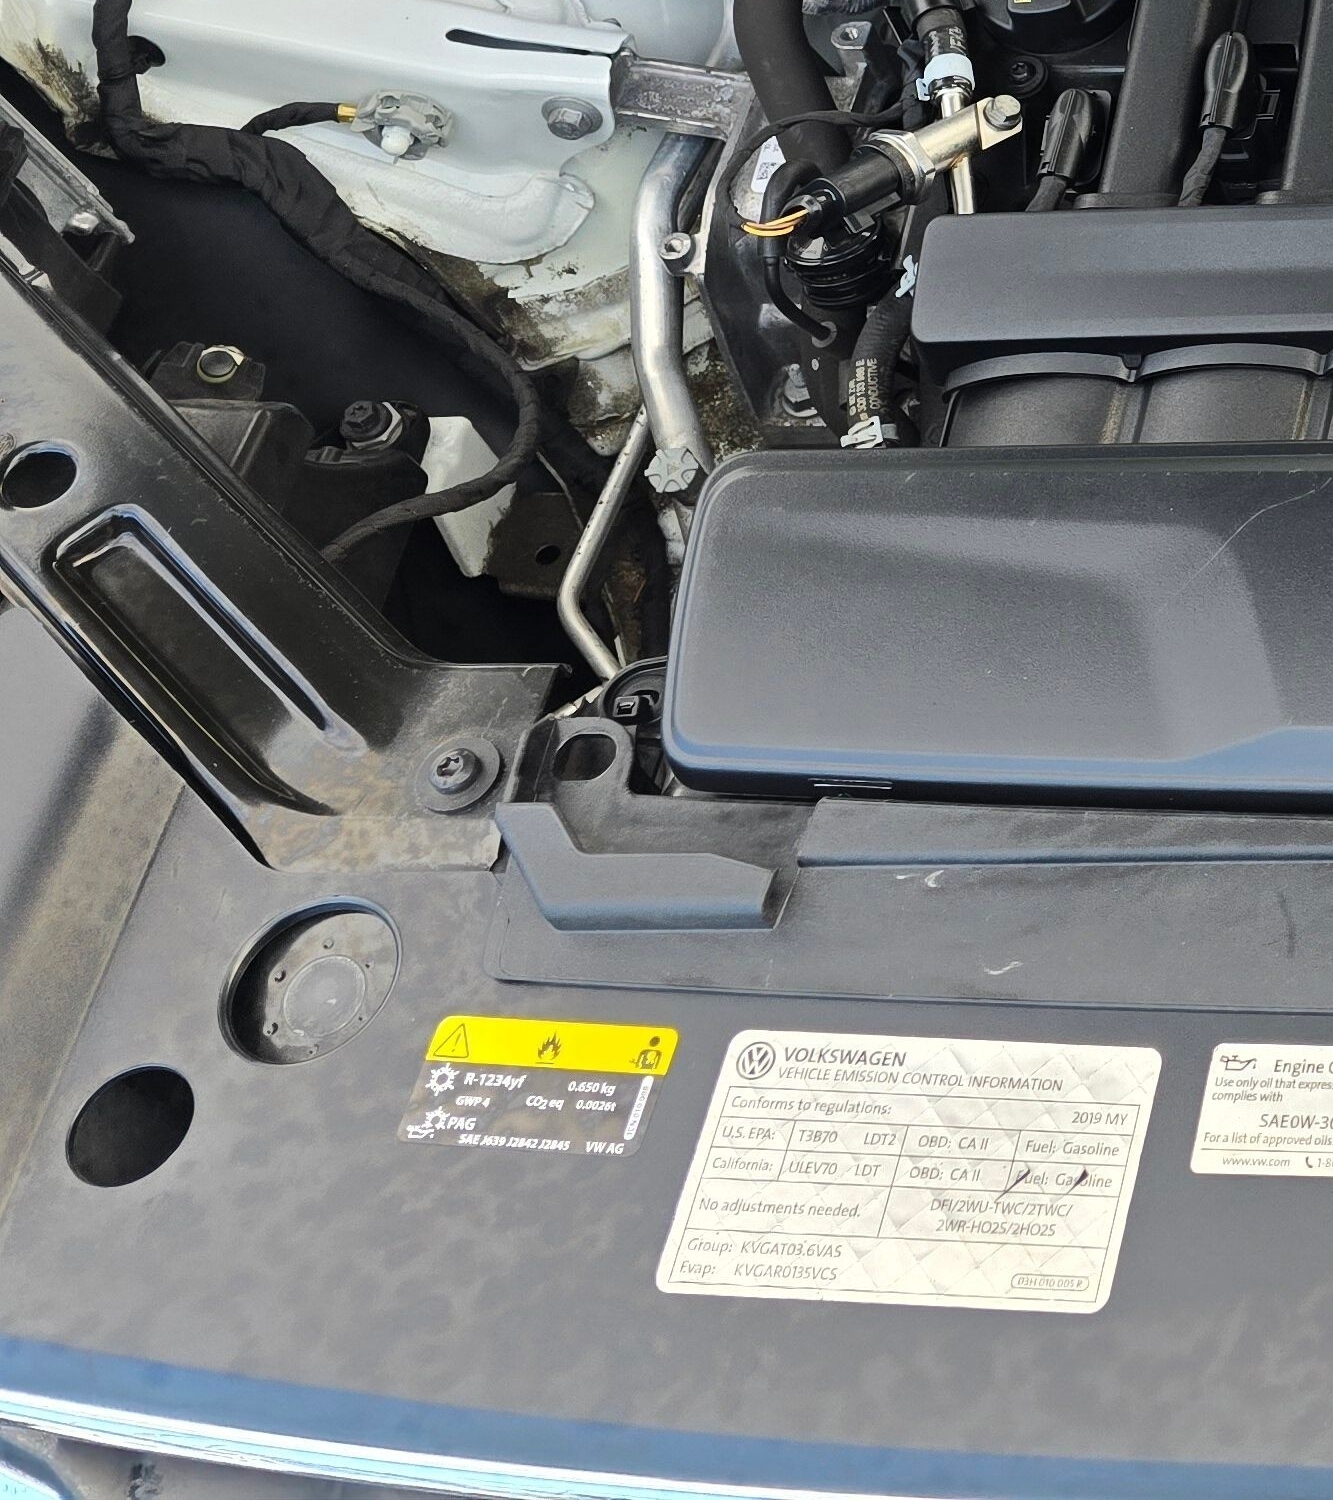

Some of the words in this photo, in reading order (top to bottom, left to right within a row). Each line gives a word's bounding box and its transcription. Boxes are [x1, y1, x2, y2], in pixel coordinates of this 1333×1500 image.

[867, 358, 881, 409] CONDUCTIVE
[784, 1046, 908, 1068] VOLKSWAGEN
[1273, 1058, 1325, 1079] Engine
[462, 1071, 528, 1092] R-1234yf
[778, 1066, 832, 1082] VEHICLE
[832, 1068, 901, 1085] EMISSION
[901, 1071, 965, 1088] CONTROL
[967, 1075, 1064, 1092] INFORMATION
[1214, 1076, 1235, 1088] Use
[1235, 1077, 1260, 1092] only
[1259, 1077, 1274, 1089] oil
[1273, 1077, 1297, 1090] that
[1211, 1090, 1259, 1103] complies
[1259, 1091, 1284, 1103] with
[730, 1095, 796, 1111] Conforms
[796, 1097, 817, 1111] to
[813, 1097, 893, 1118] regulations:
[1070, 1110, 1103, 1126] 2019
[1104, 1112, 1129, 1127] MY
[721, 1124, 746, 1140] U.S.
[747, 1126, 776, 1142] EPA:
[798, 1128, 839, 1144] T3B70
[862, 1131, 897, 1147] LDT2
[1202, 1131, 1222, 1144] For
[1230, 1131, 1248, 1145] list
[1248, 1131, 1264, 1145] of
[1261, 1133, 1314, 1148] approved
[917, 1134, 952, 1150] OBD:
[957, 1136, 977, 1151] CA
[1024, 1139, 1057, 1155] Fuel:
[1062, 1140, 1120, 1157] Gasoline
[711, 1156, 774, 1173] California:
[788, 1160, 839, 1176] ULEV70
[853, 1162, 883, 1178] LDT
[1221, 1156, 1291, 1168] www.vw.com
[908, 1165, 945, 1181] OBD:
[949, 1167, 969, 1182] CA
[698, 1197, 720, 1211] No
[720, 1197, 806, 1216] adjustments
[806, 1202, 861, 1221] needed.
[929, 1197, 1074, 1218] DFI/2WU-TWC/2TWC/
[934, 1217, 1057, 1238] 2WR-HO2S/2HO2S
[686, 1236, 734, 1256] Group:
[678, 1259, 717, 1277] Evap:
